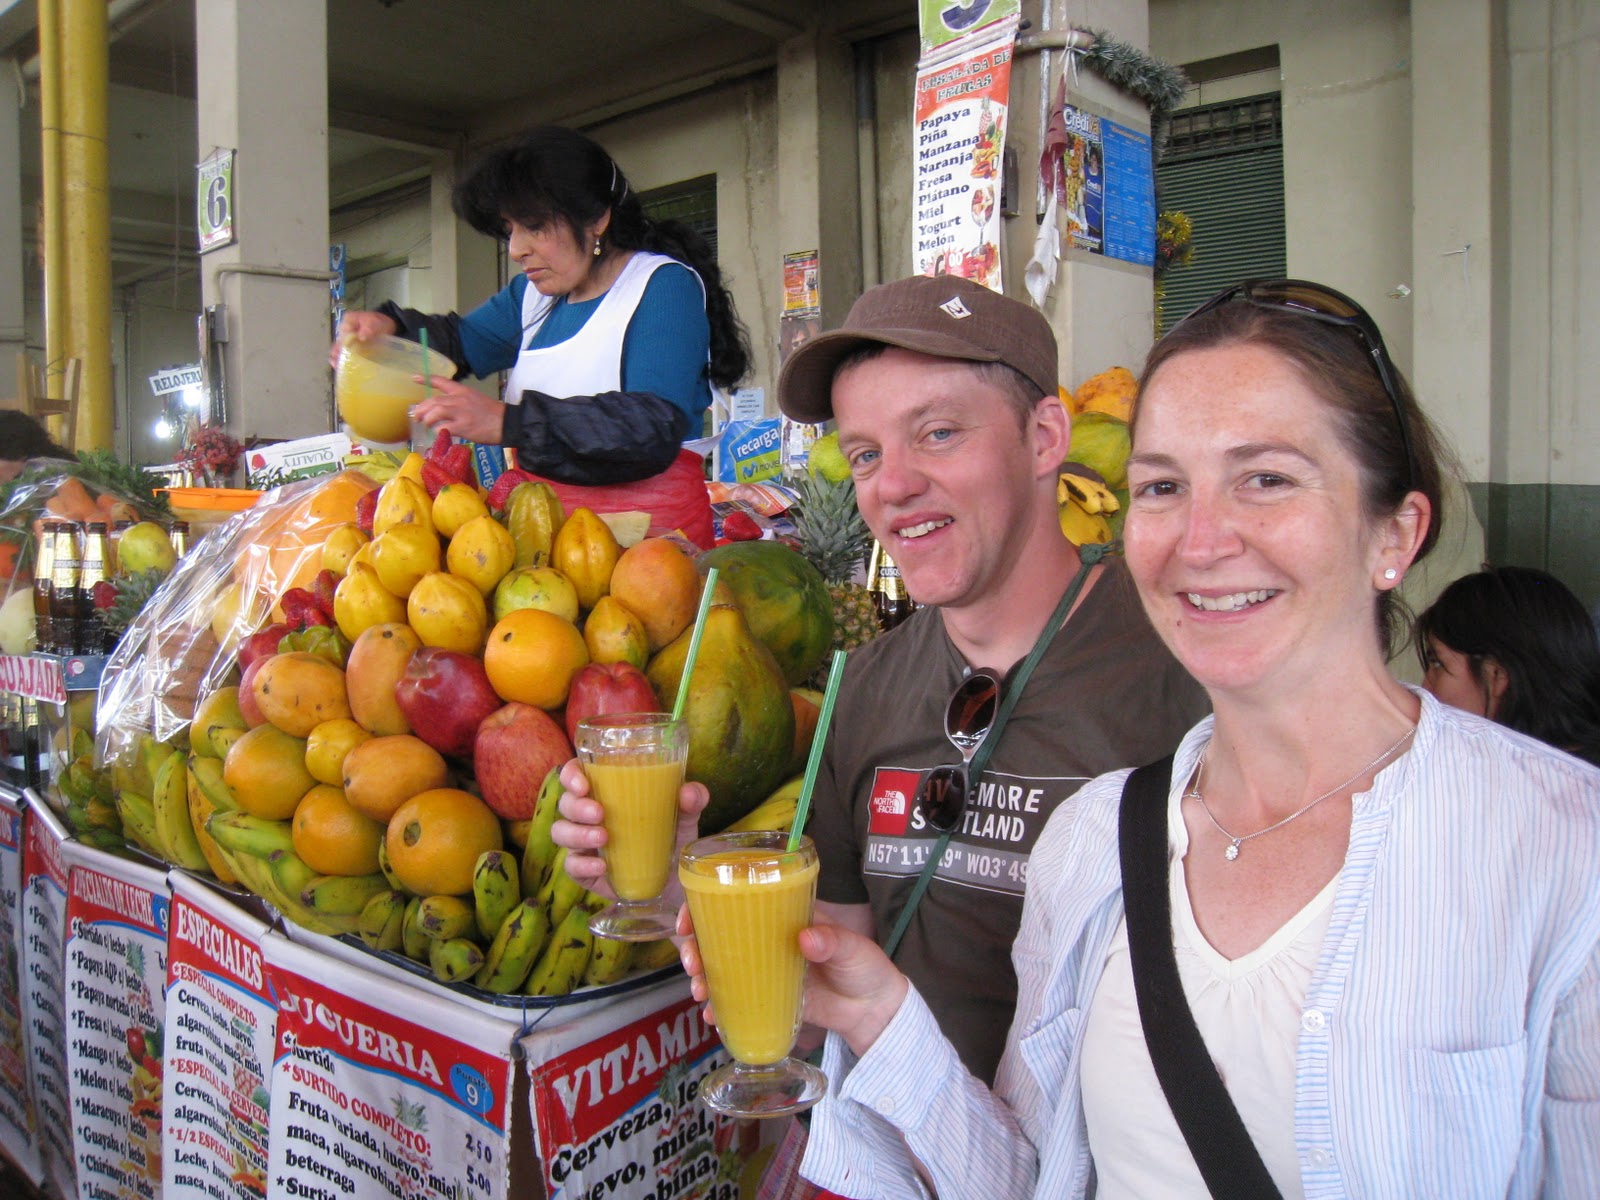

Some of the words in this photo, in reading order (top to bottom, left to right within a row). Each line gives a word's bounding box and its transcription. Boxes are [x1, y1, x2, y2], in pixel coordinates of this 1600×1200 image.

[920, 108, 971, 132] Papaya
[919, 135, 980, 161] Manzana
[920, 128, 948, 146] Piña
[919, 152, 974, 176] Naranja
[918, 173, 953, 191] Fresa
[207, 176, 227, 229] 6
[918, 184, 970, 206] Plátano
[918, 204, 944, 222] Miel
[918, 215, 961, 236] Yogurt
[918, 233, 956, 251] Melón
[283, 449, 334, 468] QUALITY
[874, 797, 894, 806] NORTH
[885, 790, 896, 798] THE
[877, 805, 894, 814] FACE
[911, 805, 1025, 842] STLAND
[176, 902, 264, 991] ESPECIALES
[77, 950, 103, 978] Papaya
[77, 981, 105, 1006] Papaya
[180, 966, 216, 1000] ESPECIAL
[216, 988, 258, 1030] COMPLETO:
[77, 1010, 102, 1032] Fresa
[78, 1039, 108, 1066] Mango
[176, 1035, 203, 1057] fruta
[244, 1058, 265, 1082] miel,
[552, 1003, 712, 1119] VITAMI
[80, 1068, 108, 1092] Melon
[175, 1081, 216, 1112] Cerveza,
[177, 1058, 220, 1092] ESPECIAL
[232, 1090, 269, 1128] CERVEZA
[466, 1083, 478, 1106] 9
[292, 1064, 348, 1110] SURTIDO
[351, 1098, 431, 1157] COMPLETO:
[83, 1125, 120, 1151] Guayaba
[288, 1091, 329, 1123] Fruta
[331, 1114, 381, 1159] variada,
[383, 1141, 425, 1188] huevo,
[552, 1103, 671, 1182] Cerveza,
[653, 1108, 714, 1162] miel,
[176, 1127, 196, 1145] 1/2
[198, 1130, 236, 1169] ESPECIAL
[174, 1148, 209, 1174] Leche,
[285, 1148, 356, 1194] beterraga
[286, 1124, 330, 1156] maca,
[333, 1142, 405, 1200] algarrobina,
[174, 1173, 207, 1195] maca,
